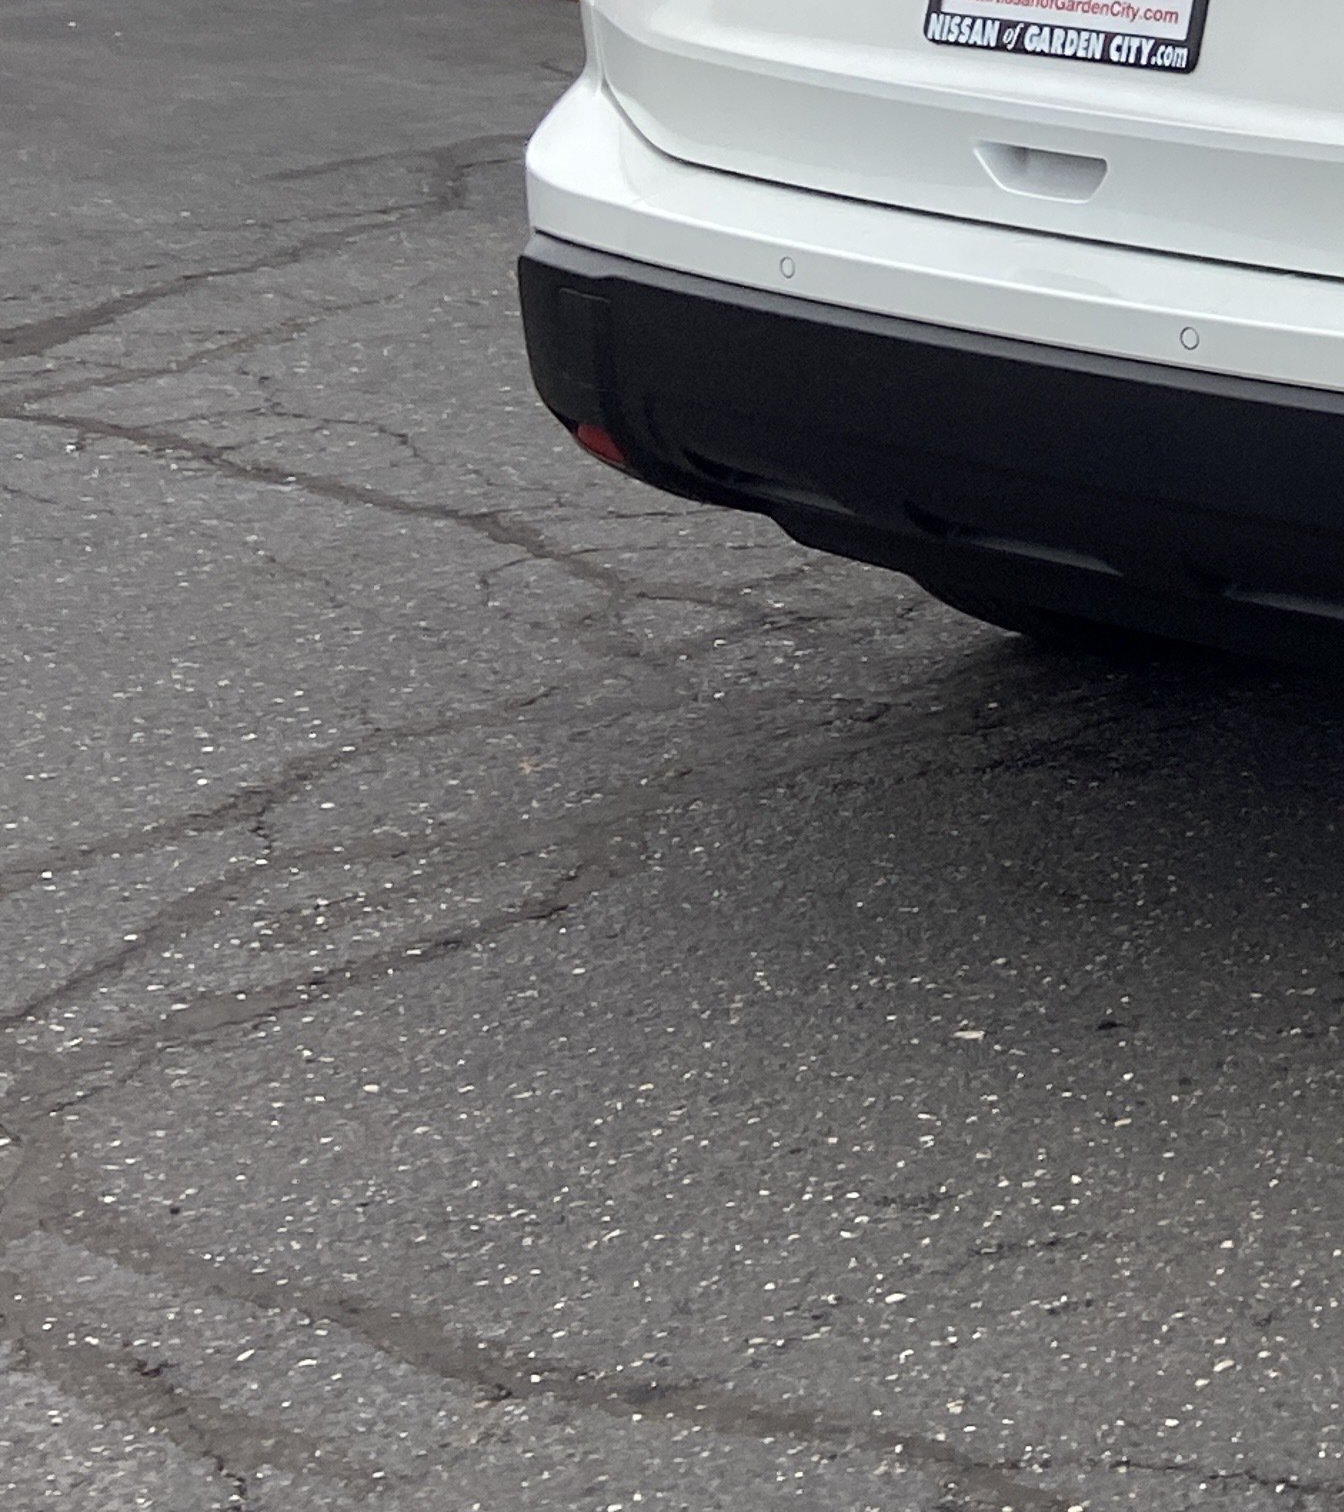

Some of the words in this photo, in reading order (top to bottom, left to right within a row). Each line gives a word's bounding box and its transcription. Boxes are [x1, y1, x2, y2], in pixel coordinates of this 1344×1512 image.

[927, 12, 1001, 47] NISSAN
[1002, 22, 1024, 50] of
[1024, 23, 1106, 60] GARDEN
[1108, 38, 1190, 68] CITY.com
